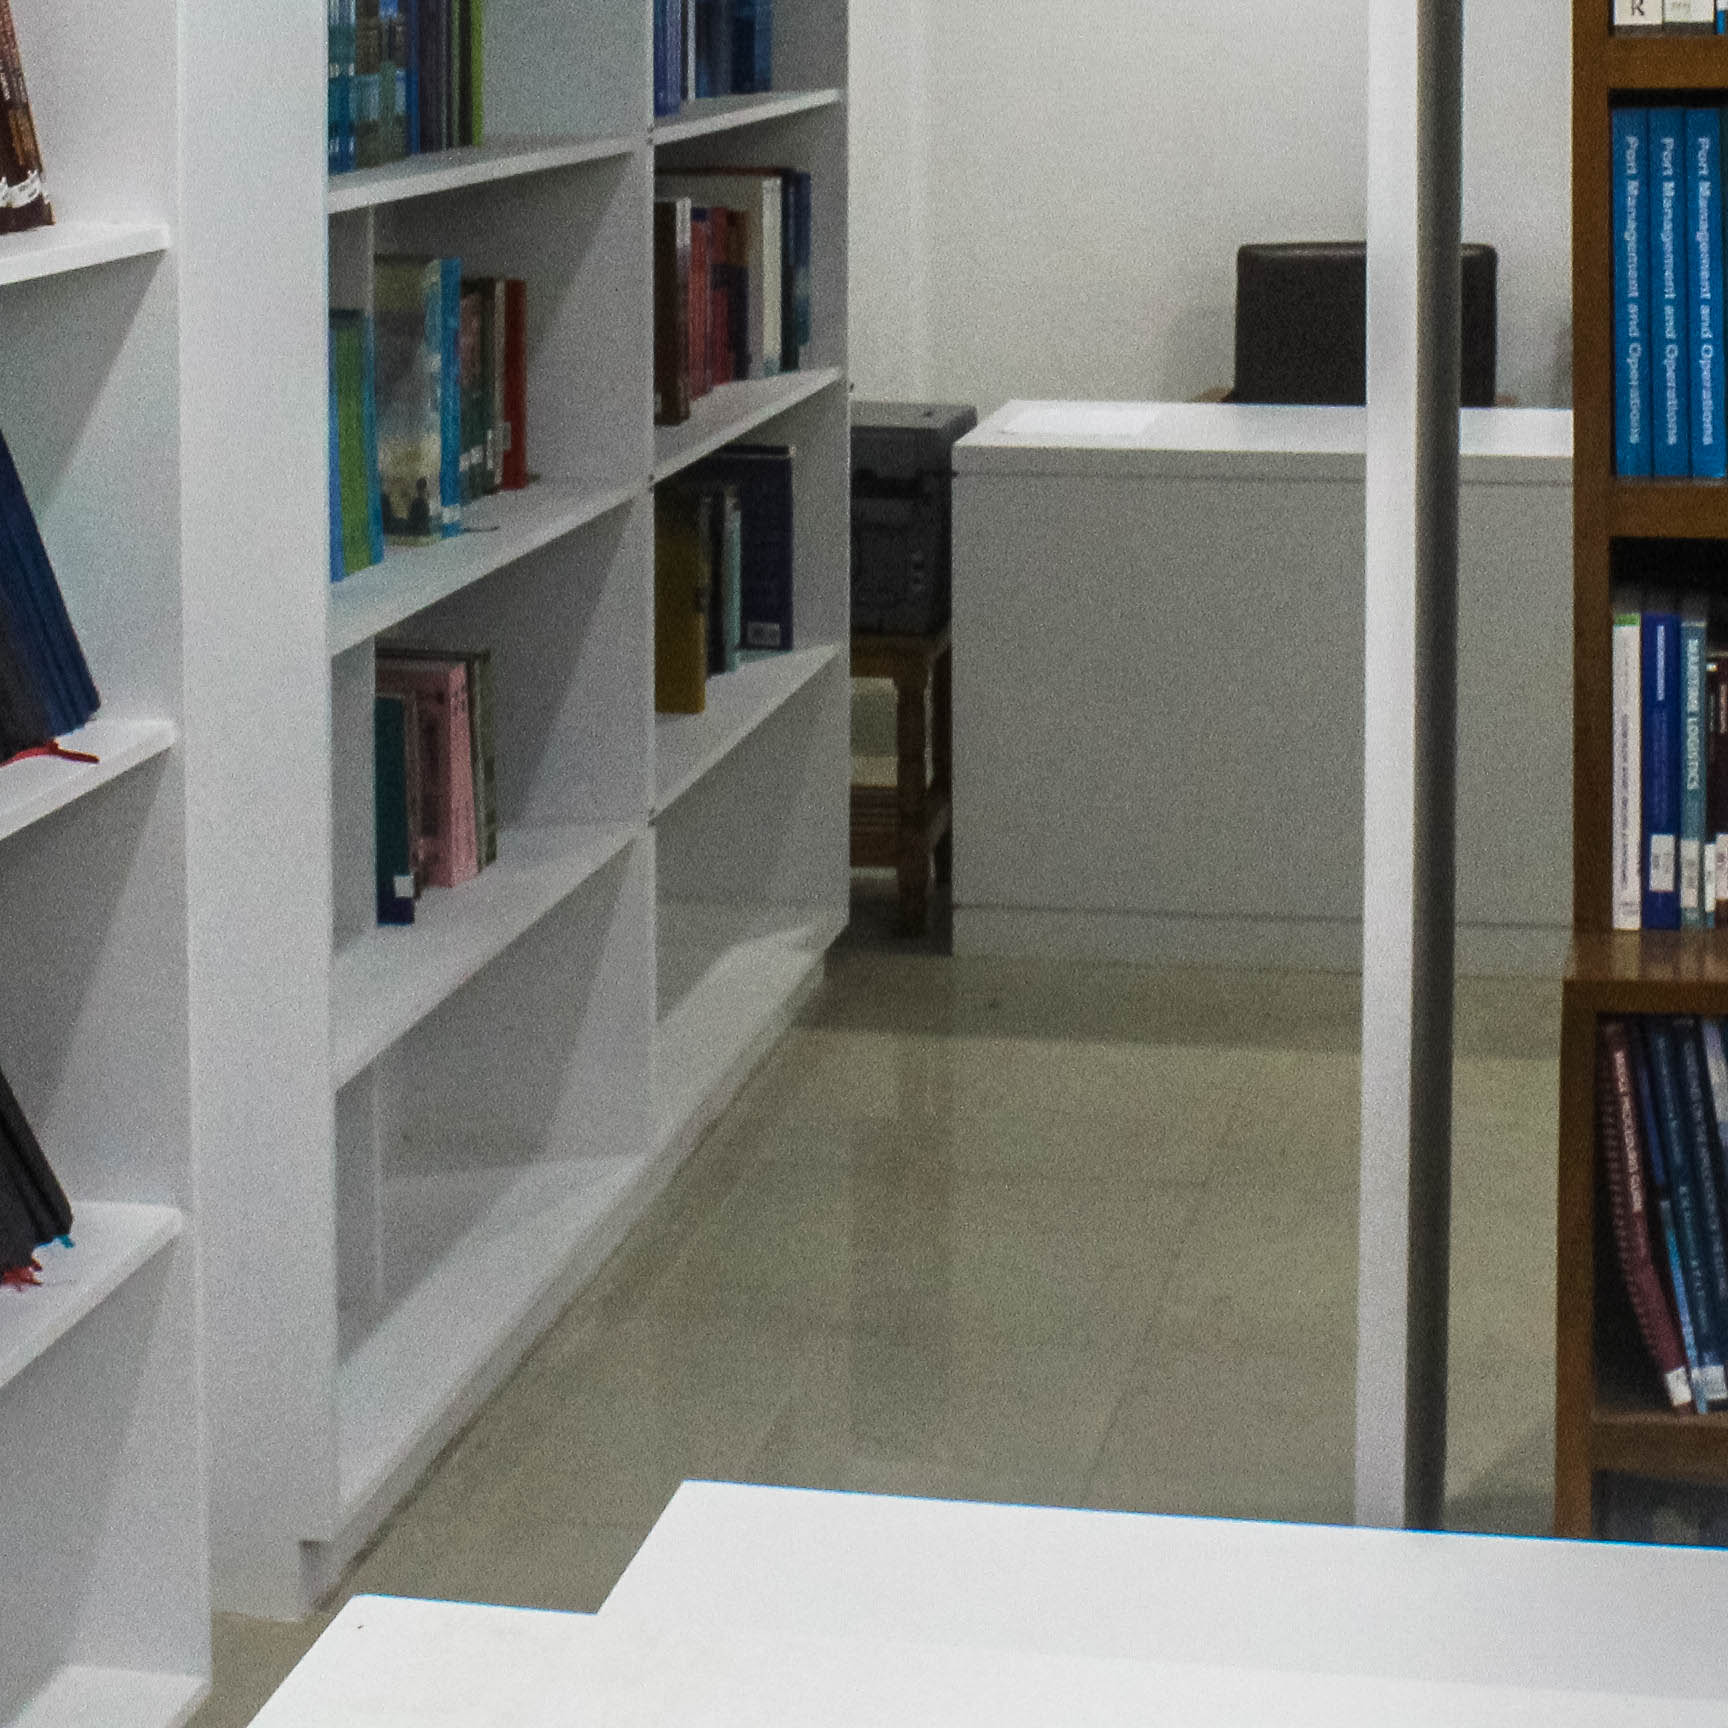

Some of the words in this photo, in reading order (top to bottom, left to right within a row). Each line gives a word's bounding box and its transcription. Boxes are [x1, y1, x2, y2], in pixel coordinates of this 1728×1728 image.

[1624, 180, 1640, 299] Management
[1660, 181, 1676, 300] Management
[1697, 181, 1713, 300] Management
